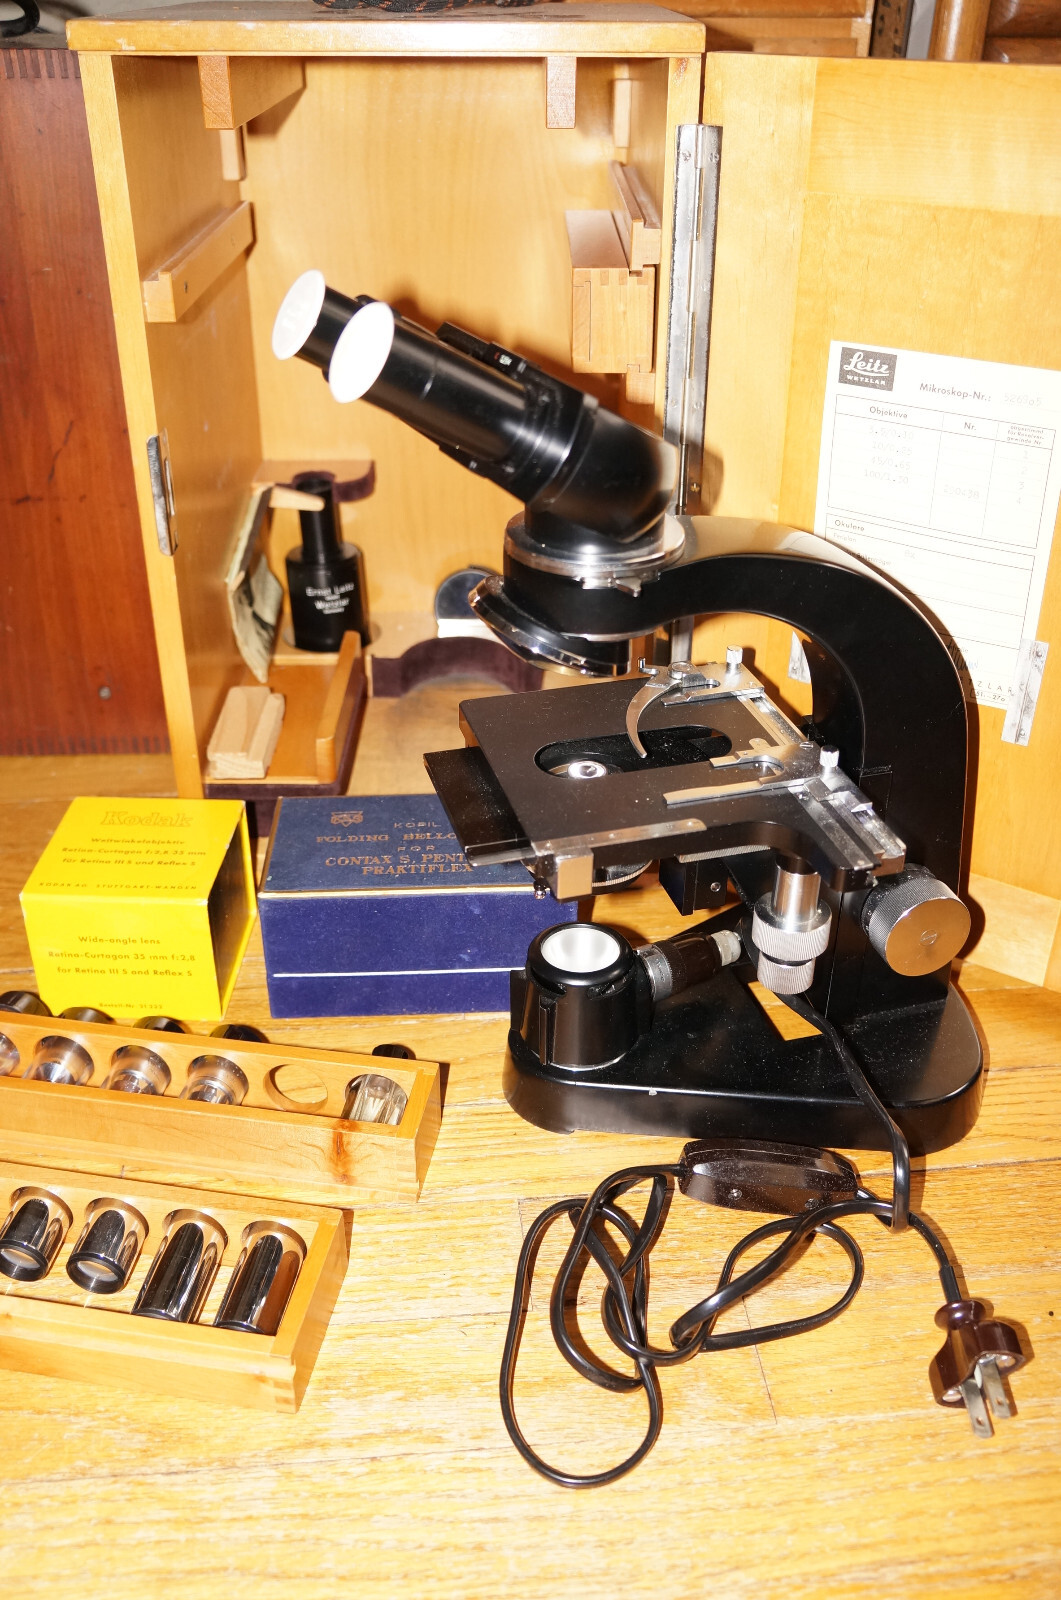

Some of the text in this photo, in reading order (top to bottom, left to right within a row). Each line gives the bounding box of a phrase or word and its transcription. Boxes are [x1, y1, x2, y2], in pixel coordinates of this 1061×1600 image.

[843, 352, 890, 376] Leitz
[846, 375, 886, 386] WETZLAR
[869, 405, 908, 420] Objektive
[964, 421, 977, 431] Nr.
[100, 810, 194, 828] Kodak
[316, 832, 457, 843] FOLDING BELLO
[325, 855, 393, 867] CONTAX
[400, 854, 416, 865] S,
[361, 864, 475, 876] PRAKTIFLEX
[78, 936, 161, 946] Wide-angle lens
[48, 951, 130, 961] Retina-Curtagon
[133, 953, 146, 961] 35
[57, 966, 72, 974] for
[75, 967, 106, 975] Retina
[153, 969, 184, 977] Reflex
